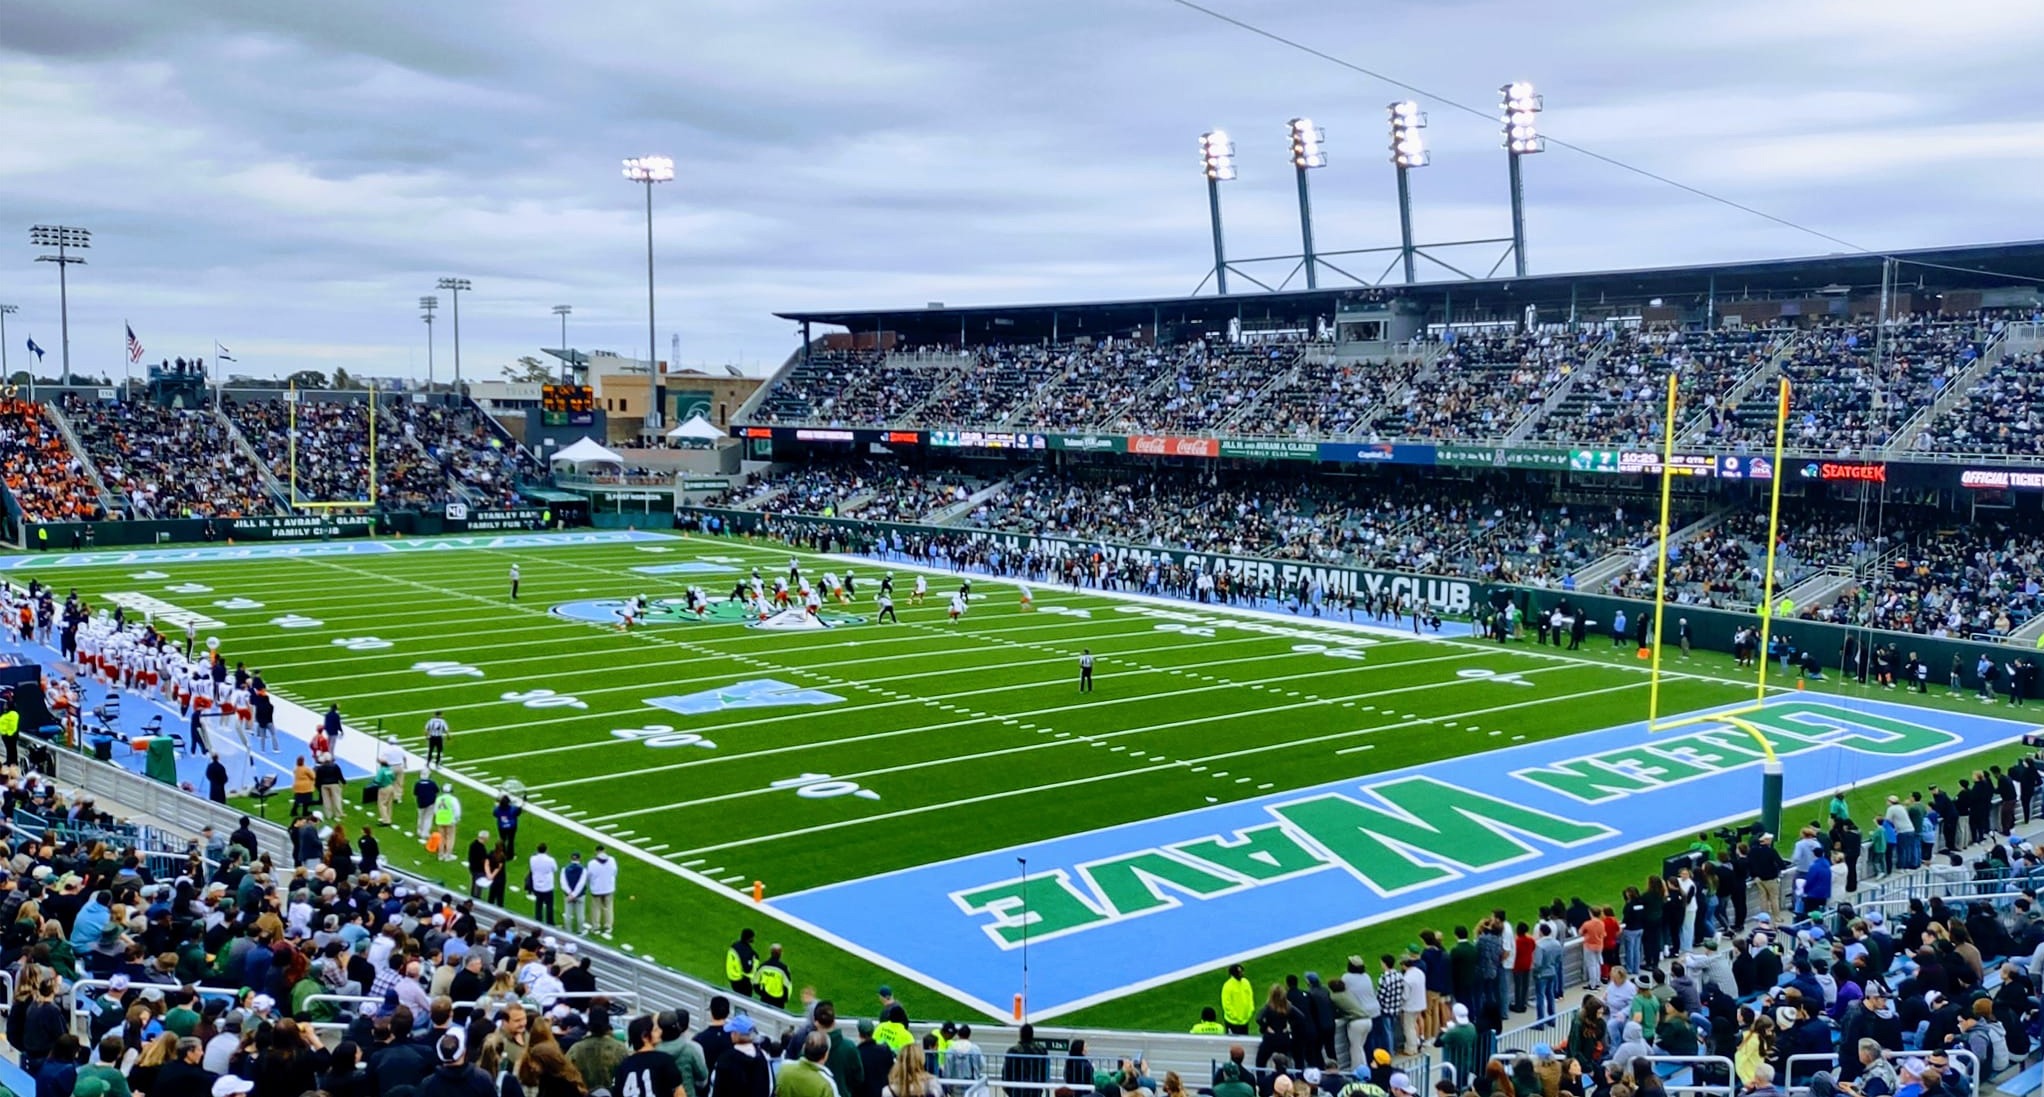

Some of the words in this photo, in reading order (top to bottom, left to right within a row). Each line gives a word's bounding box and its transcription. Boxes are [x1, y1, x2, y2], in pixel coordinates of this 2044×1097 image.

[1221, 441, 1236, 449] JILL
[1287, 443, 1317, 451] GLAZER
[1600, 452, 1611, 464] 7
[1621, 452, 1659, 464] 10:29
[1725, 457, 1738, 469] 0
[1822, 464, 1886, 482] SEATGEEK
[1961, 471, 2008, 486] OFFICIAL
[477, 511, 517, 520] STANLEY
[233, 519, 256, 528] JILL
[284, 517, 320, 526] AVRAM
[336, 516, 369, 524] GLAZE
[467, 521, 500, 529] FAMILY
[272, 527, 310, 537] FAMILY
[1282, 563, 1384, 600] FAMILY
[1391, 576, 1471, 611] CLUB
[501, 688, 578, 709] 30
[610, 724, 703, 748] 20
[770, 772, 860, 799] 10
[622, 1068, 656, 1097] 41
